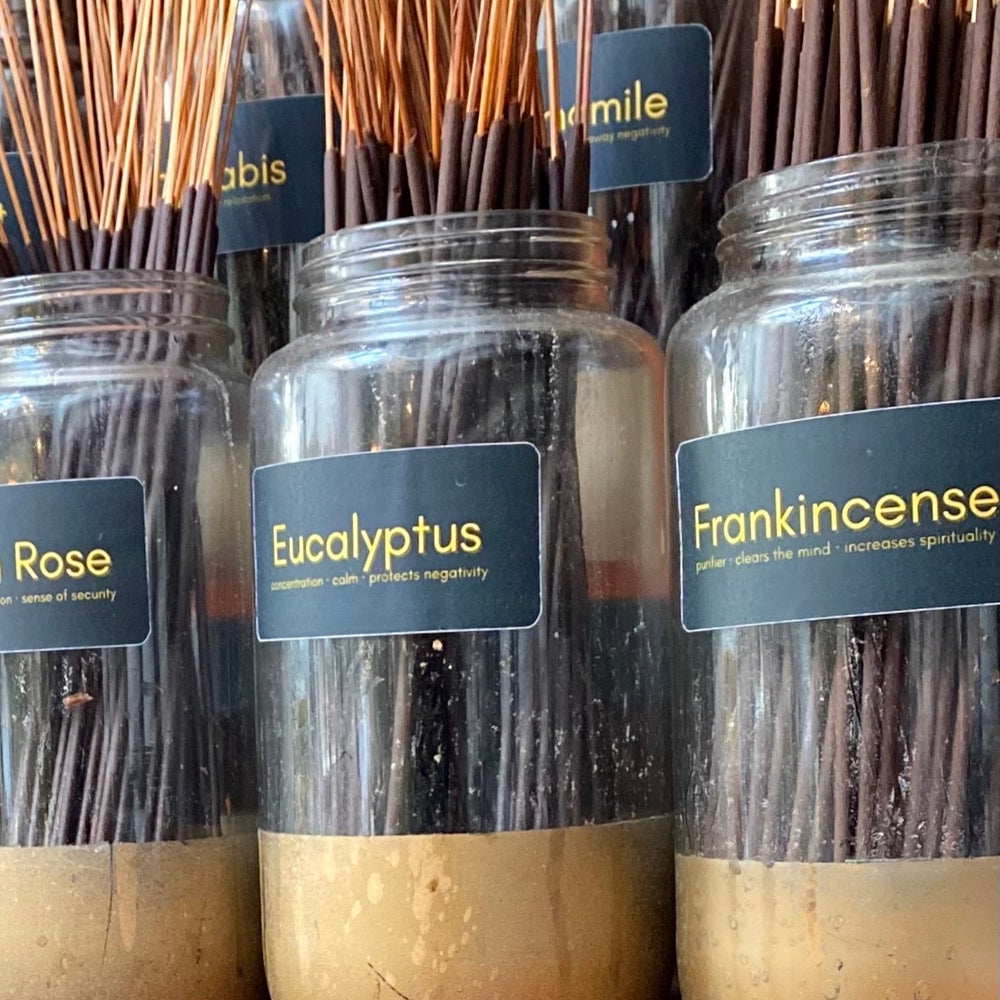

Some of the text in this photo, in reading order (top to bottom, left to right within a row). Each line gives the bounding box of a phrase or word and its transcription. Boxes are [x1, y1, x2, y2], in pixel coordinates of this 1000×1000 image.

[694, 485, 999, 549] Frankincense
[14, 540, 112, 581] Rose
[272, 512, 483, 573] Eucalyptus
[696, 526, 996, 575] purifier clears the mind increases spirituality
[21, 591, 53, 604] sense
[56, 588, 68, 602] of
[71, 588, 117, 602] security
[271, 566, 489, 591] concentration calm protects negativity
